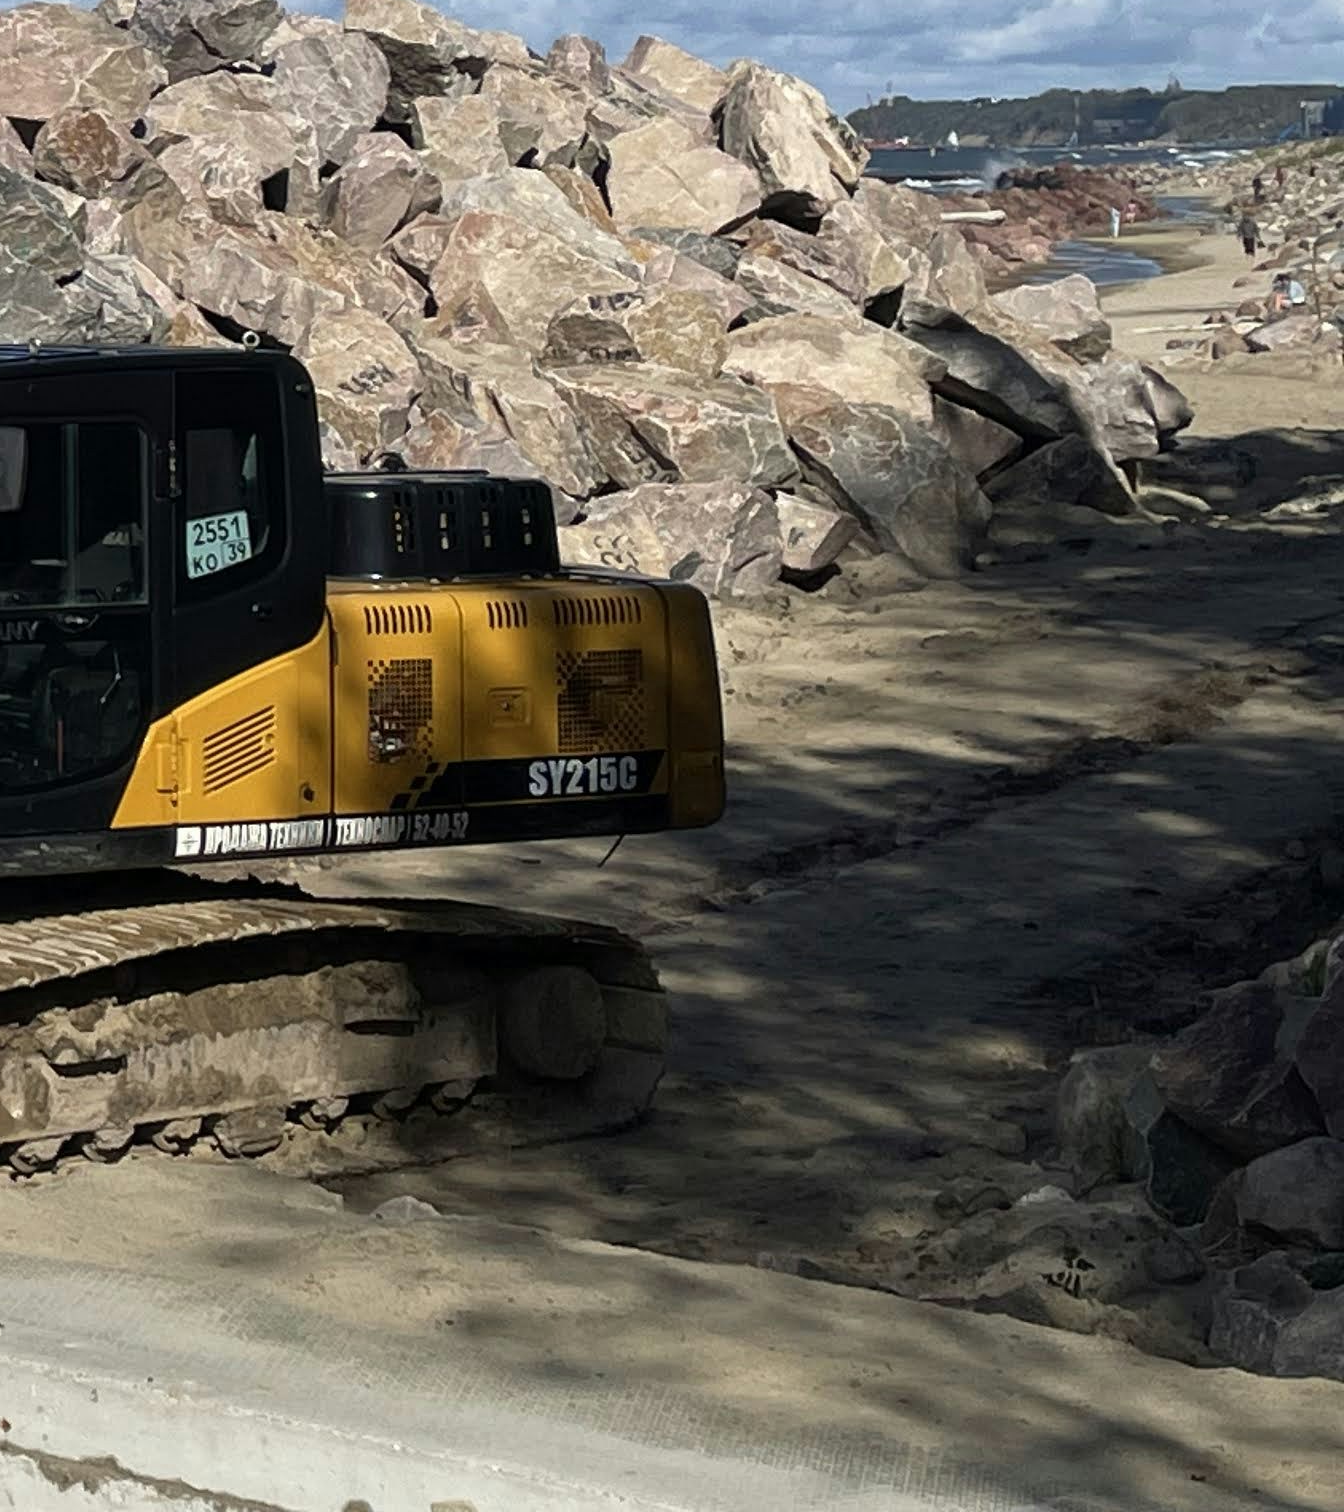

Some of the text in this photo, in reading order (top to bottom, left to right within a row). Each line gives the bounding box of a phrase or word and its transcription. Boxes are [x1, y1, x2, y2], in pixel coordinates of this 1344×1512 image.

[192, 515, 241, 546] 2551
[228, 541, 246, 562] 39
[529, 755, 638, 796] SY215C
[203, 823, 267, 854] ПРОДАЖА
